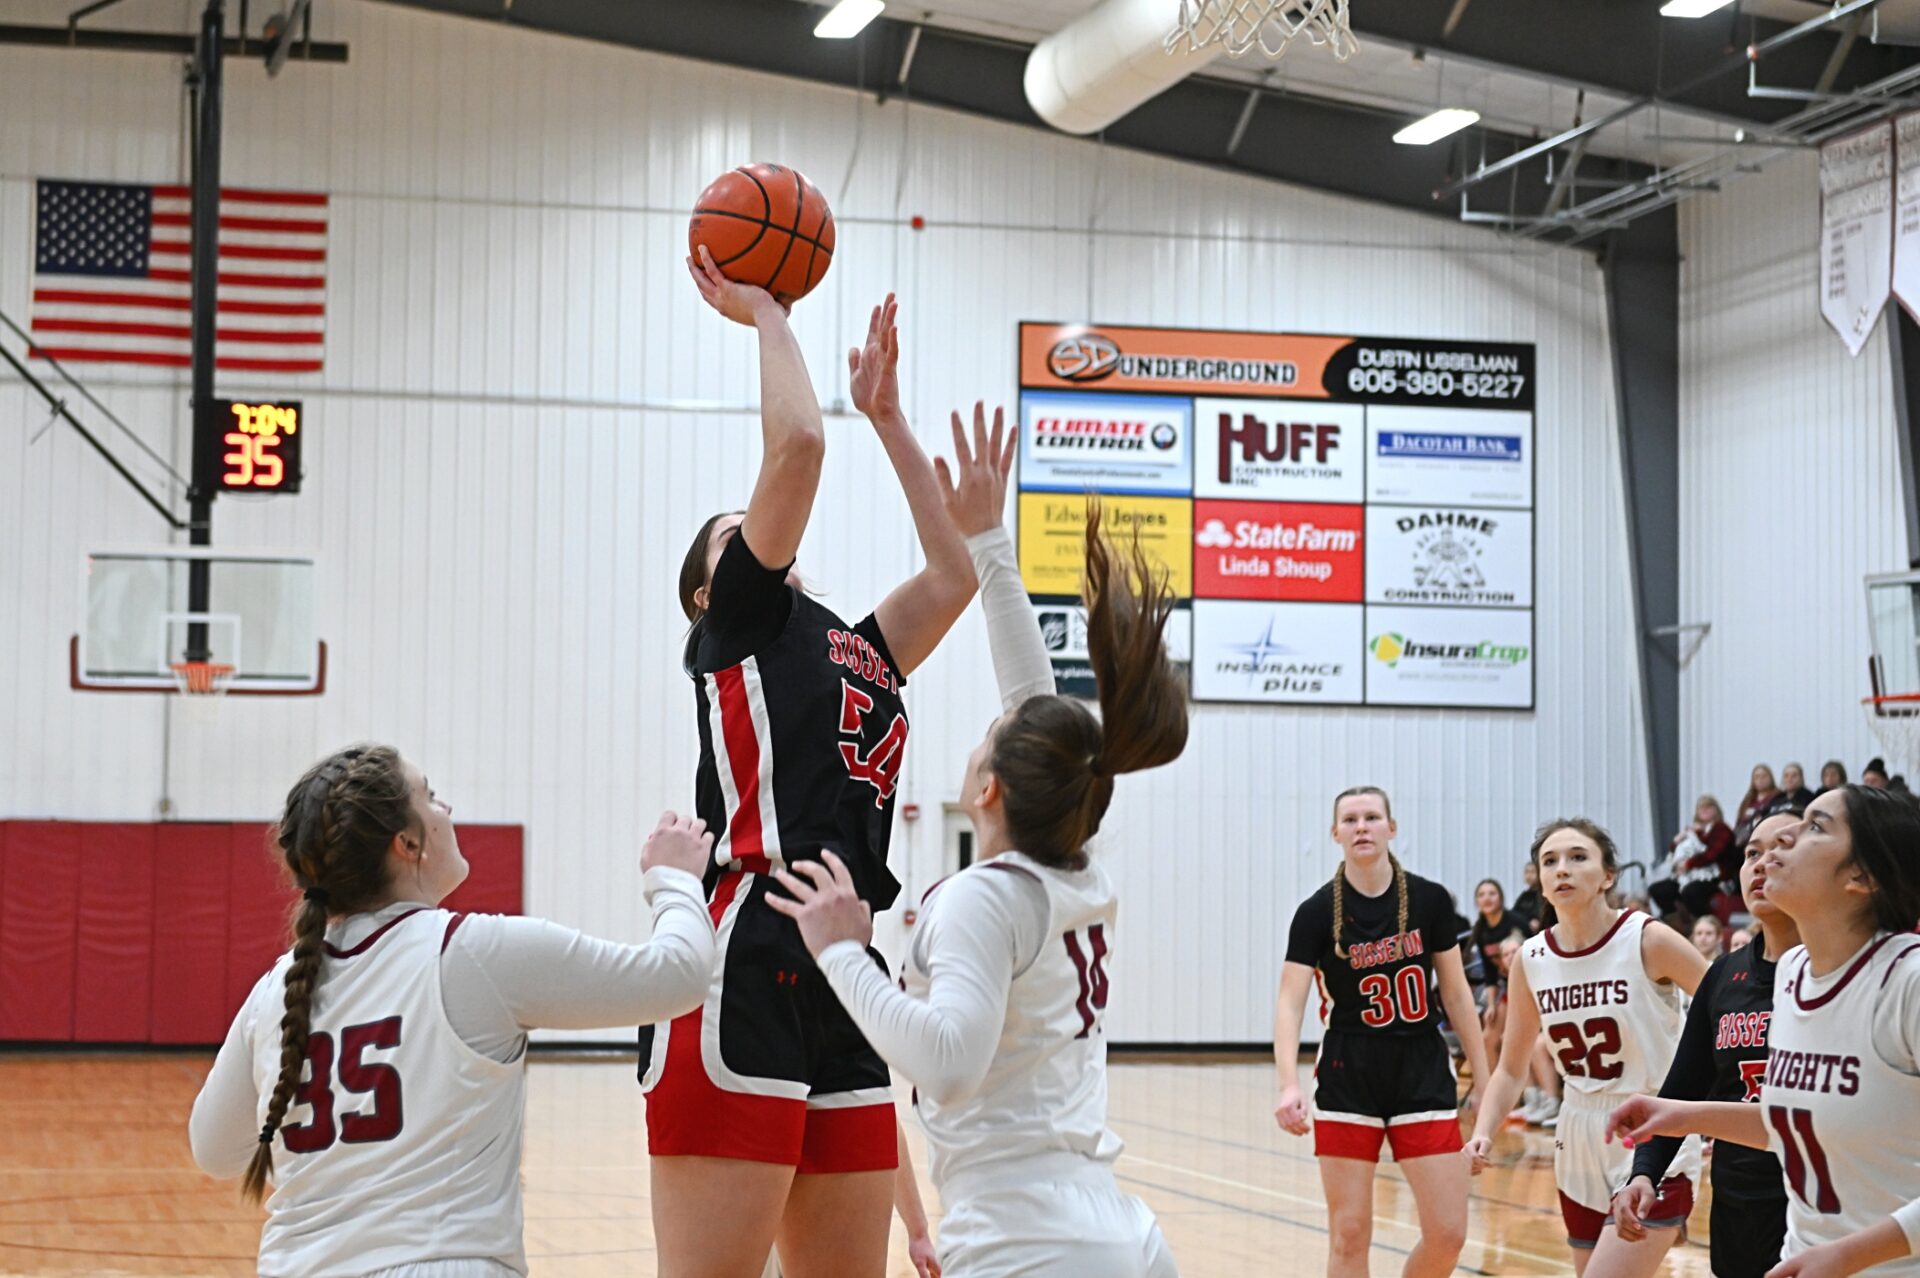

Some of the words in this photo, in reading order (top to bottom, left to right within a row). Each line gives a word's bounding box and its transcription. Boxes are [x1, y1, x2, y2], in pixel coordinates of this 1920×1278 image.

[1118, 355, 1297, 387] UNDERGROUND
[1358, 348, 1421, 369] DUSTIN
[1425, 351, 1518, 373] USSELMAN
[1347, 368, 1525, 398] 605-380-5227
[231, 403, 297, 436] 7:04
[1036, 417, 1147, 434] CLIMATE
[1035, 435, 1147, 450] CONTROL
[1218, 413, 1341, 484] HUFF
[223, 433, 284, 486] 35
[1236, 466, 1342, 479] CONSTRUCTION
[1236, 477, 1258, 487] INC
[1396, 512, 1498, 536] DAHME
[1219, 555, 1271, 577] Linda
[1274, 556, 1333, 583] Shoup
[1384, 589, 1515, 603] CONSTRUCTION
[1403, 639, 1529, 665] InsuraCrop
[1216, 662, 1344, 677] INSURANCE
[1262, 677, 1324, 694] plus
[838, 677, 909, 810] 54
[1359, 964, 1429, 1028] 30
[1537, 979, 1629, 1014] KNIGHTS
[1549, 1016, 1625, 1081] 22
[280, 1015, 404, 1154] 35
[1764, 1048, 1861, 1097] NIGHTS
[1768, 1105, 1841, 1214] 11
